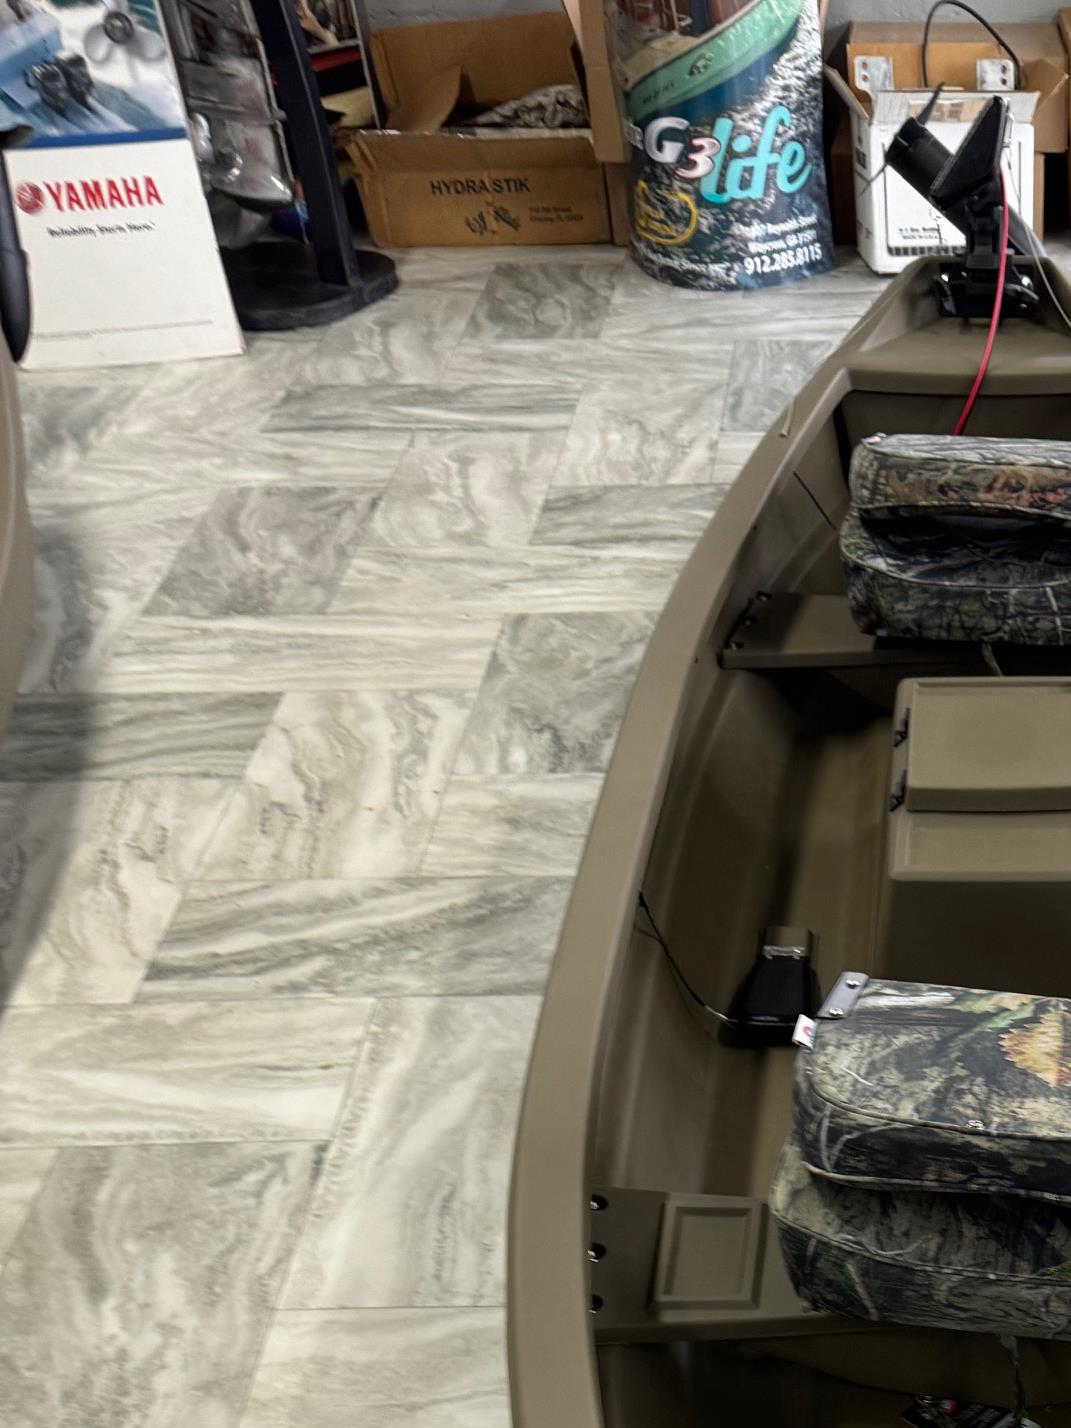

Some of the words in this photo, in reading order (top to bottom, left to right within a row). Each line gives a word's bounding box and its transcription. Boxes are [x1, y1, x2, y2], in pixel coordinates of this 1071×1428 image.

[644, 116, 720, 178] G3
[700, 105, 812, 204] life
[44, 175, 164, 212] YAMAHA
